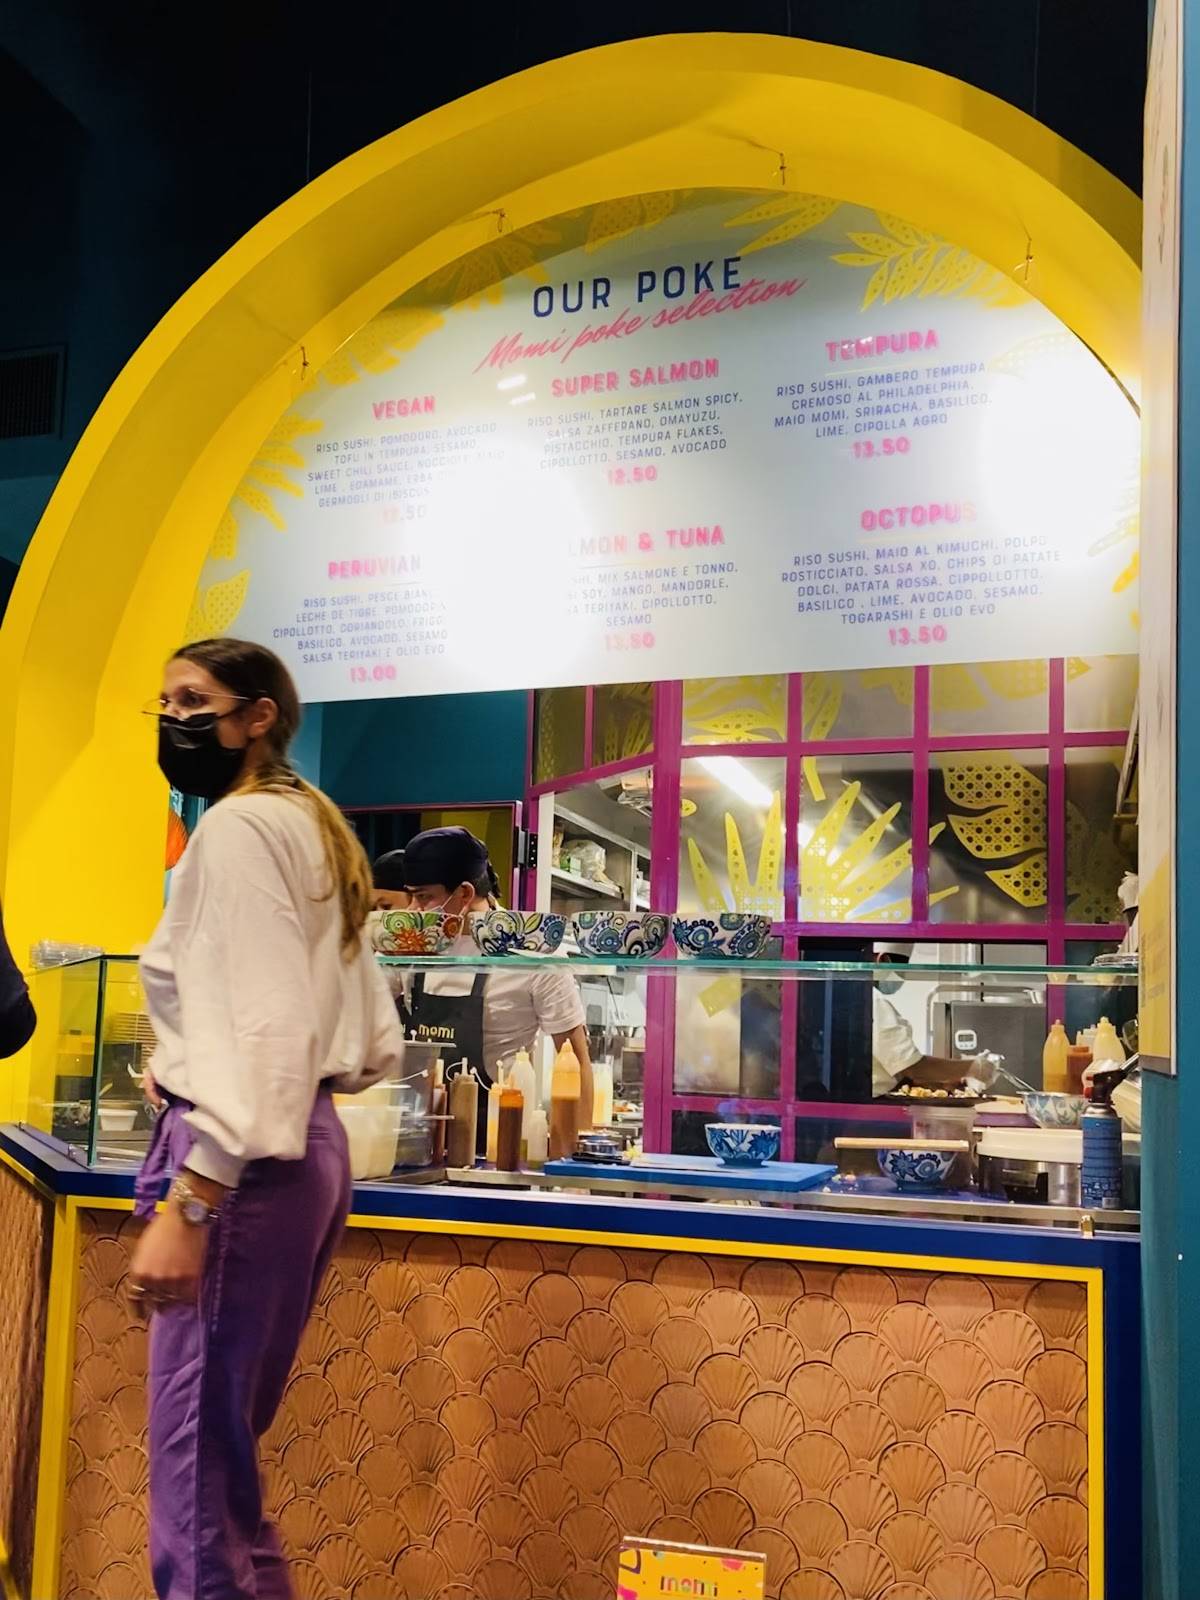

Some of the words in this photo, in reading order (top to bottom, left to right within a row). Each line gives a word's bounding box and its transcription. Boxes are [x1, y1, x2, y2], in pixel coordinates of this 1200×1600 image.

[533, 277, 612, 318] OUR
[637, 256, 742, 303] POKE
[473, 329, 570, 374] Momi
[561, 308, 651, 364] poke
[652, 275, 808, 329] selection
[824, 329, 939, 362] TEMPURA
[552, 371, 619, 398] SUPER
[629, 358, 719, 388] SALMON
[777, 384, 804, 397] RISO
[857, 370, 919, 387] GAMBERO
[372, 396, 436, 420] VEGAN
[792, 394, 851, 410] CREMOSO
[858, 391, 873, 401] AL
[528, 416, 552, 428] RISO
[600, 404, 648, 418] TARTARE
[653, 398, 700, 413] SALMON
[774, 414, 805, 427] MAIO
[854, 418, 906, 433] CIPOLLA
[913, 413, 948, 426] AGRO
[316, 442, 338, 453] RISO
[619, 431, 671, 446] TEMPURA
[671, 439, 727, 454] AVOCADO
[853, 436, 911, 459] 13.50
[335, 454, 359, 464] TOFU
[365, 452, 373, 460] IN
[307, 469, 340, 481] SWEET
[860, 502, 978, 531] OCTOPUS
[665, 525, 725, 548] TUNA
[793, 553, 822, 567] RISO
[876, 546, 909, 560] MAIO
[915, 544, 930, 557] AL
[1004, 535, 1047, 549] POLPO
[328, 554, 422, 579] PERUVIAN
[874, 562, 913, 575] SALSA
[947, 556, 986, 570] CHIPS
[993, 554, 1006, 565] DI
[1013, 550, 1061, 564] PATATE
[598, 573, 618, 584] MIX
[624, 567, 677, 581] SALMONE
[683, 566, 689, 576] E
[845, 580, 889, 593] PATATA
[303, 598, 326, 608] RISO
[296, 612, 327, 623] LECHE
[332, 610, 343, 620] DE
[606, 614, 652, 627] SESAMO
[841, 611, 913, 625] TOGARASHI
[919, 608, 926, 619] E
[933, 605, 963, 618] OLIO
[970, 603, 996, 616] EVO
[887, 624, 948, 646] 13.50
[303, 652, 333, 663] SALSA
[396, 646, 420, 656] OLIO
[425, 644, 445, 655] EVO
[419, 1024, 455, 1039] momi
